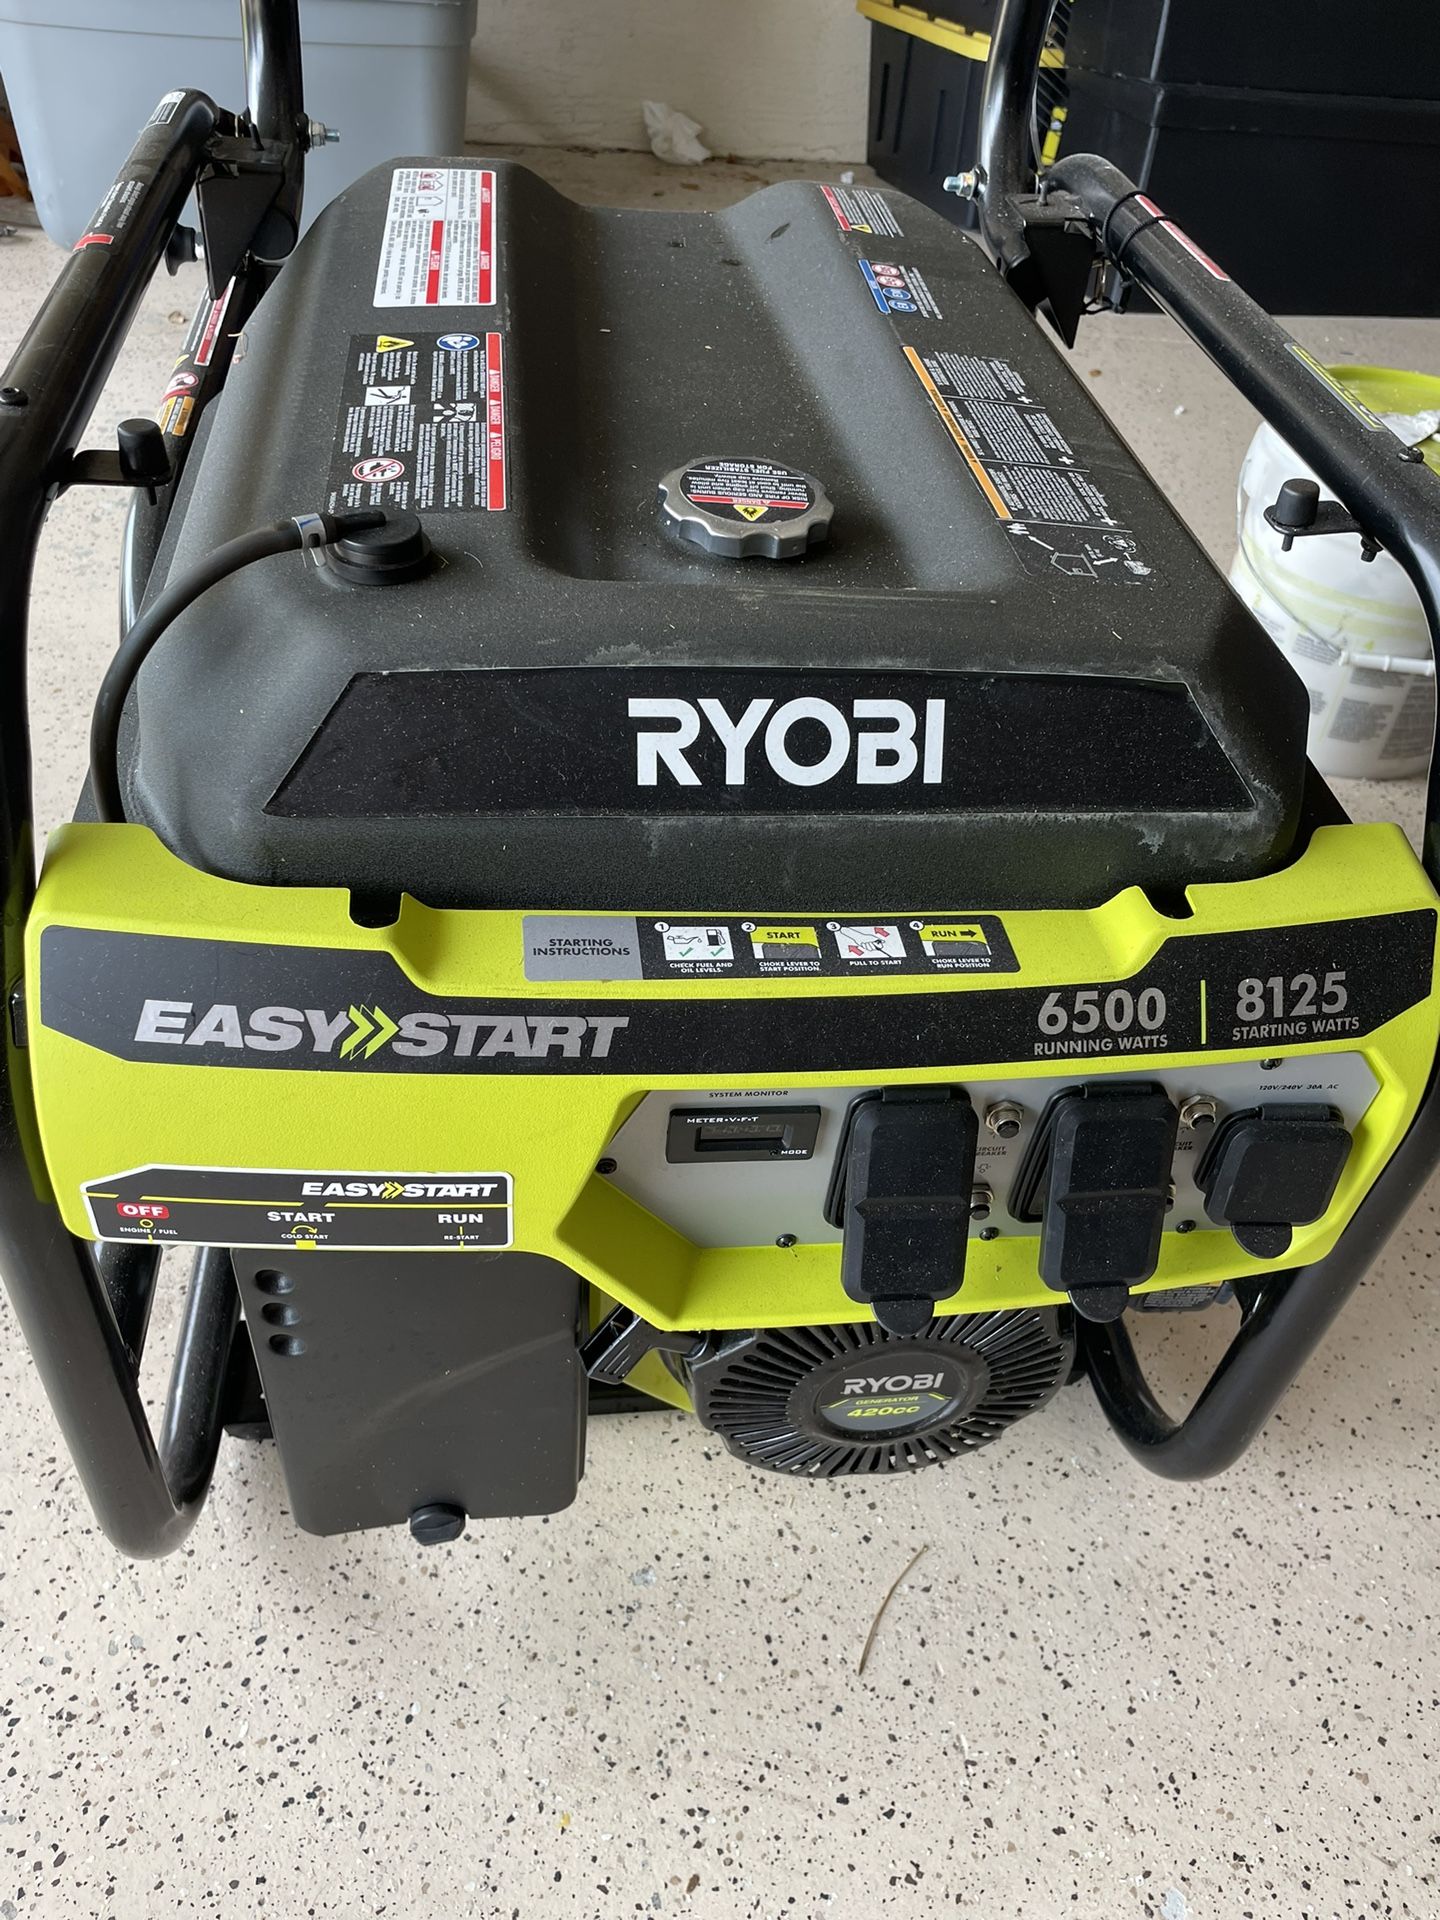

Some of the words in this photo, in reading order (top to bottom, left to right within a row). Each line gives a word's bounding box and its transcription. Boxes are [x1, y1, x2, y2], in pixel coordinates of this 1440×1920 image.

[704, 464, 749, 473] STABILIZER
[719, 461, 755, 469] STORAGE
[628, 697, 945, 786] RYOBI
[549, 938, 613, 947] STARTING
[533, 947, 630, 956] INSTRUCTIONS
[1236, 971, 1348, 1022] 8125
[1037, 987, 1167, 1035] 6500
[134, 999, 349, 1053] EASY
[391, 1013, 629, 1058] START
[1232, 1022, 1307, 1041] STARTING
[1311, 1017, 1360, 1033] WATTS
[1033, 1037, 1113, 1056] RUNNING
[1118, 1034, 1168, 1050] WATTS
[301, 1182, 386, 1197] EASY
[402, 1183, 498, 1197] START
[122, 1205, 163, 1217] OFF
[267, 1211, 335, 1223] START
[438, 1213, 483, 1224] RUN
[120, 1226, 151, 1234] ENGINE
[843, 1373, 944, 1395] RYOBI
[855, 1395, 920, 1405] GENERATOR
